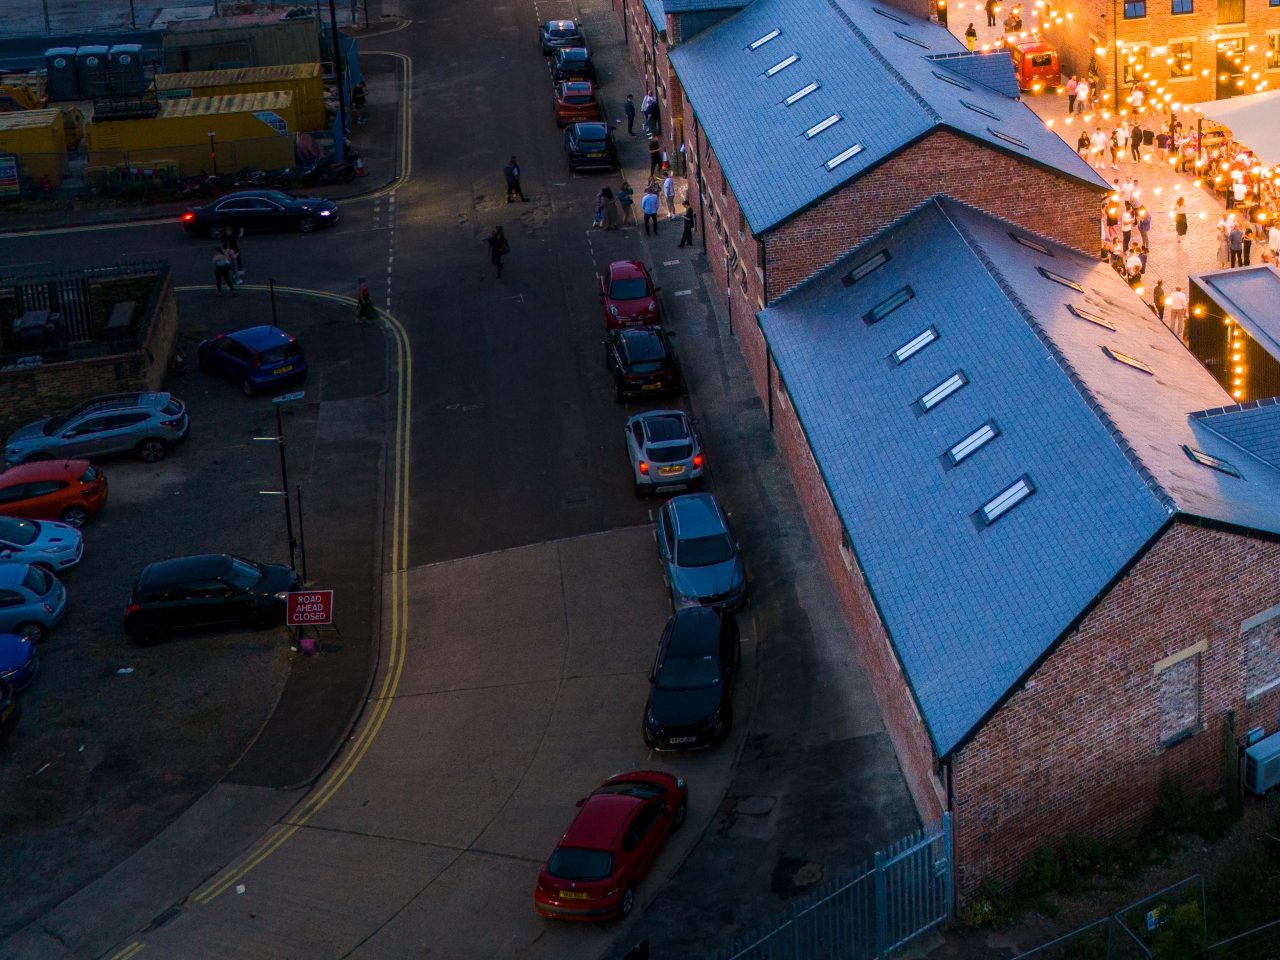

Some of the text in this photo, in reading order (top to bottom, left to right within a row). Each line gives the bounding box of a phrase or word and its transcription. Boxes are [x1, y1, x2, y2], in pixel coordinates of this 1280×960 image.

[298, 595, 322, 603] ROAD
[295, 603, 324, 612] AHEAD
[293, 612, 326, 621] CLOSED
